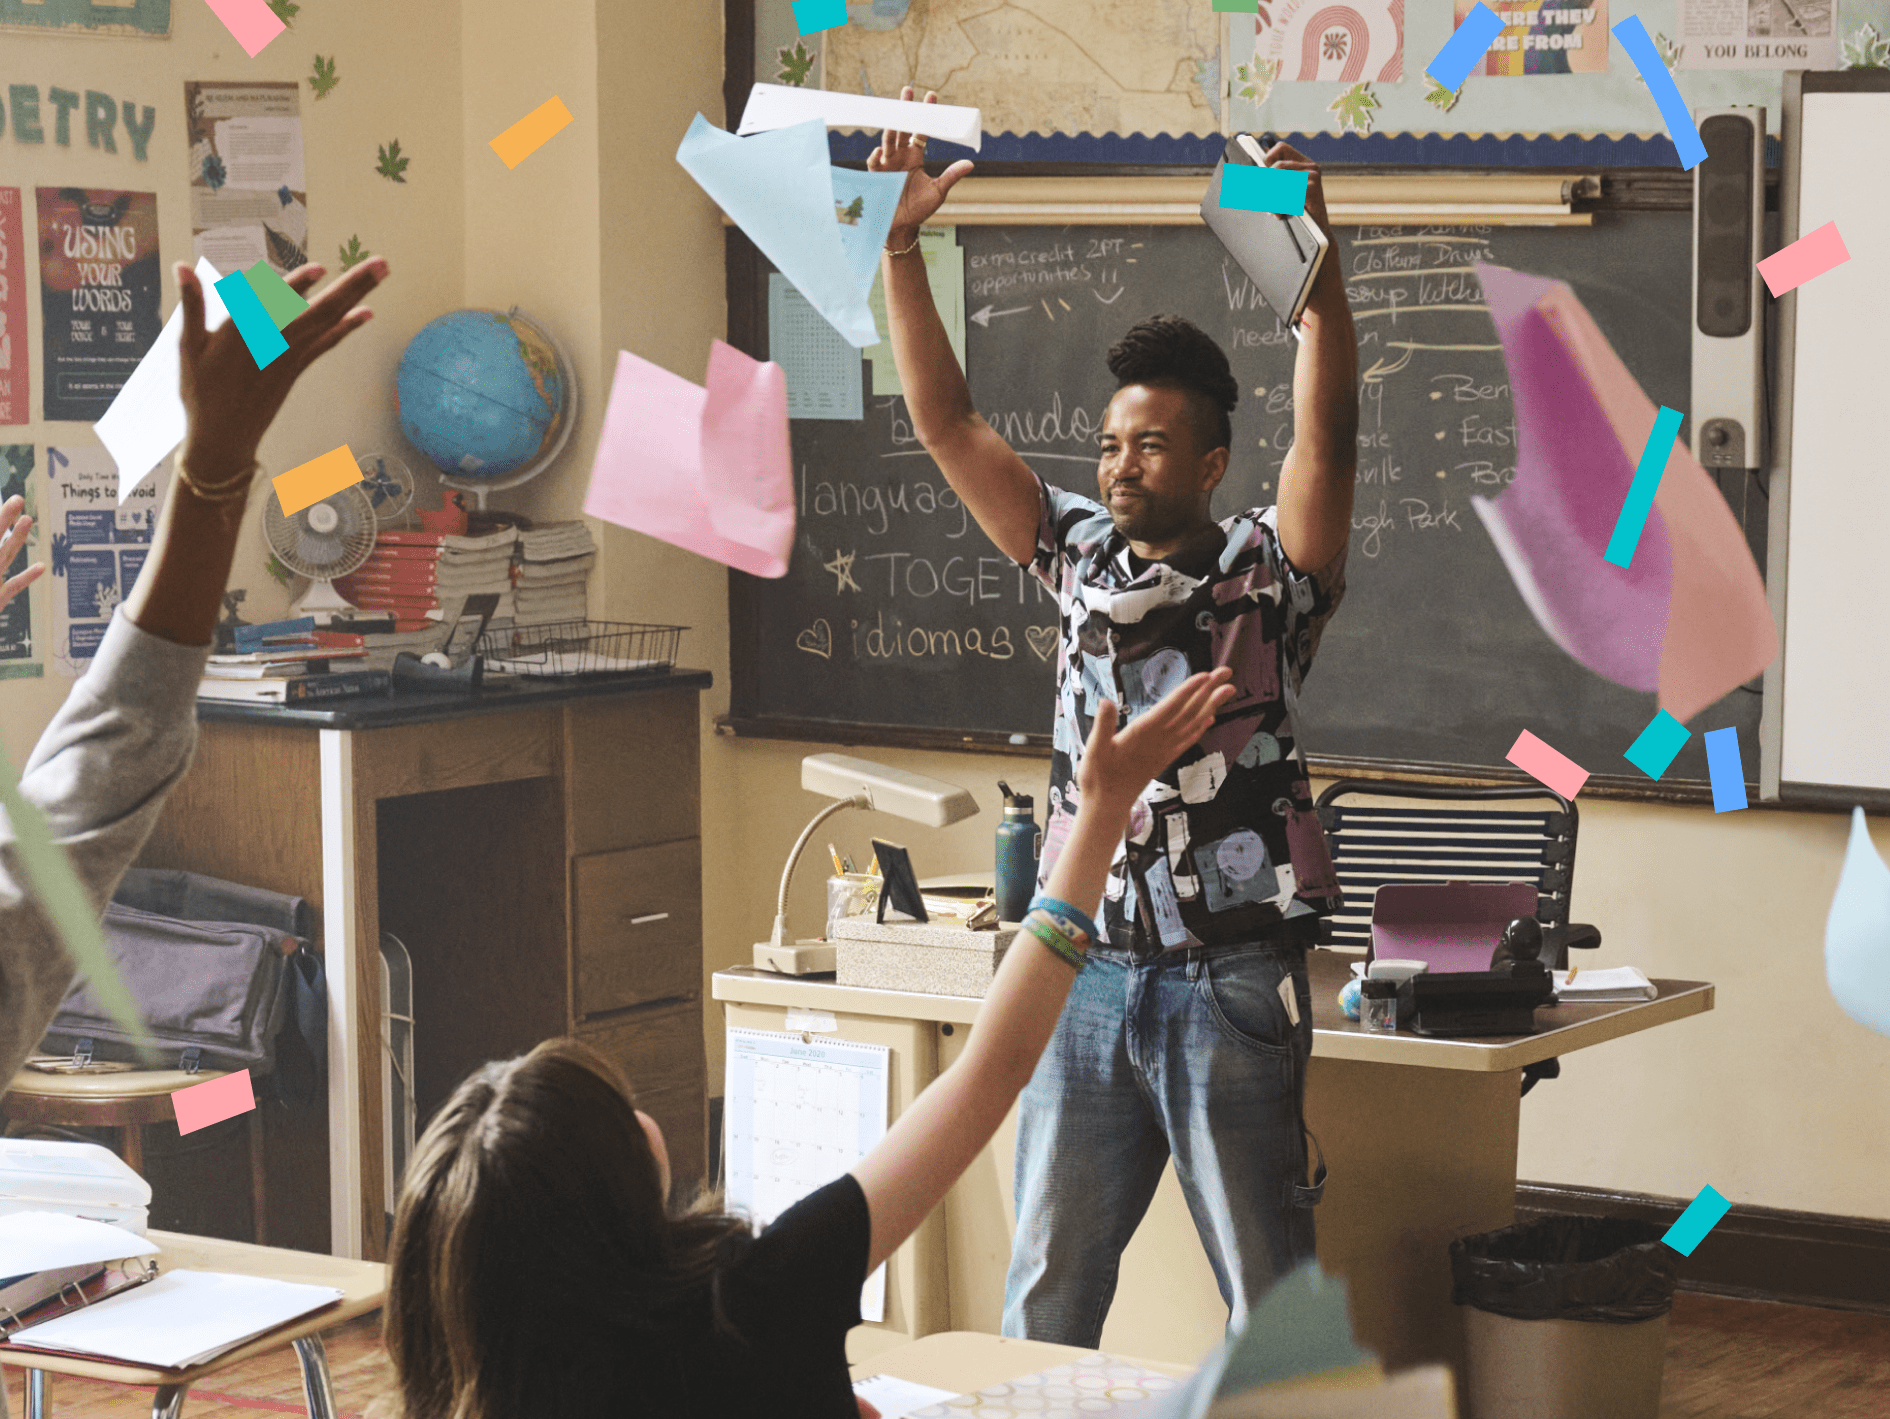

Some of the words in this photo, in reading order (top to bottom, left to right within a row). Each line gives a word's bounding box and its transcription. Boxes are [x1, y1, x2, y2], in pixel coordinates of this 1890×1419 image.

[1540, 8, 1597, 25] THEY
[1522, 34, 1583, 50] FROM
[1704, 44, 1737, 58] YOU
[1744, 44, 1808, 58] BELONG
[0, 83, 156, 162] ETRY
[62, 224, 137, 260] USING
[970, 252, 1015, 268] extra
[77, 262, 123, 287] YOUR
[971, 264, 1092, 296] opportunities
[71, 288, 132, 313] WORDS
[1430, 373, 1509, 401] Ben
[61, 482, 100, 503] Things
[104, 485, 118, 498] to
[800, 463, 969, 539] languag
[1399, 498, 1462, 532] Park
[850, 610, 1015, 660] idiomas
[790, 1047, 807, 1058] June
[808, 1049, 826, 1059] 2020
